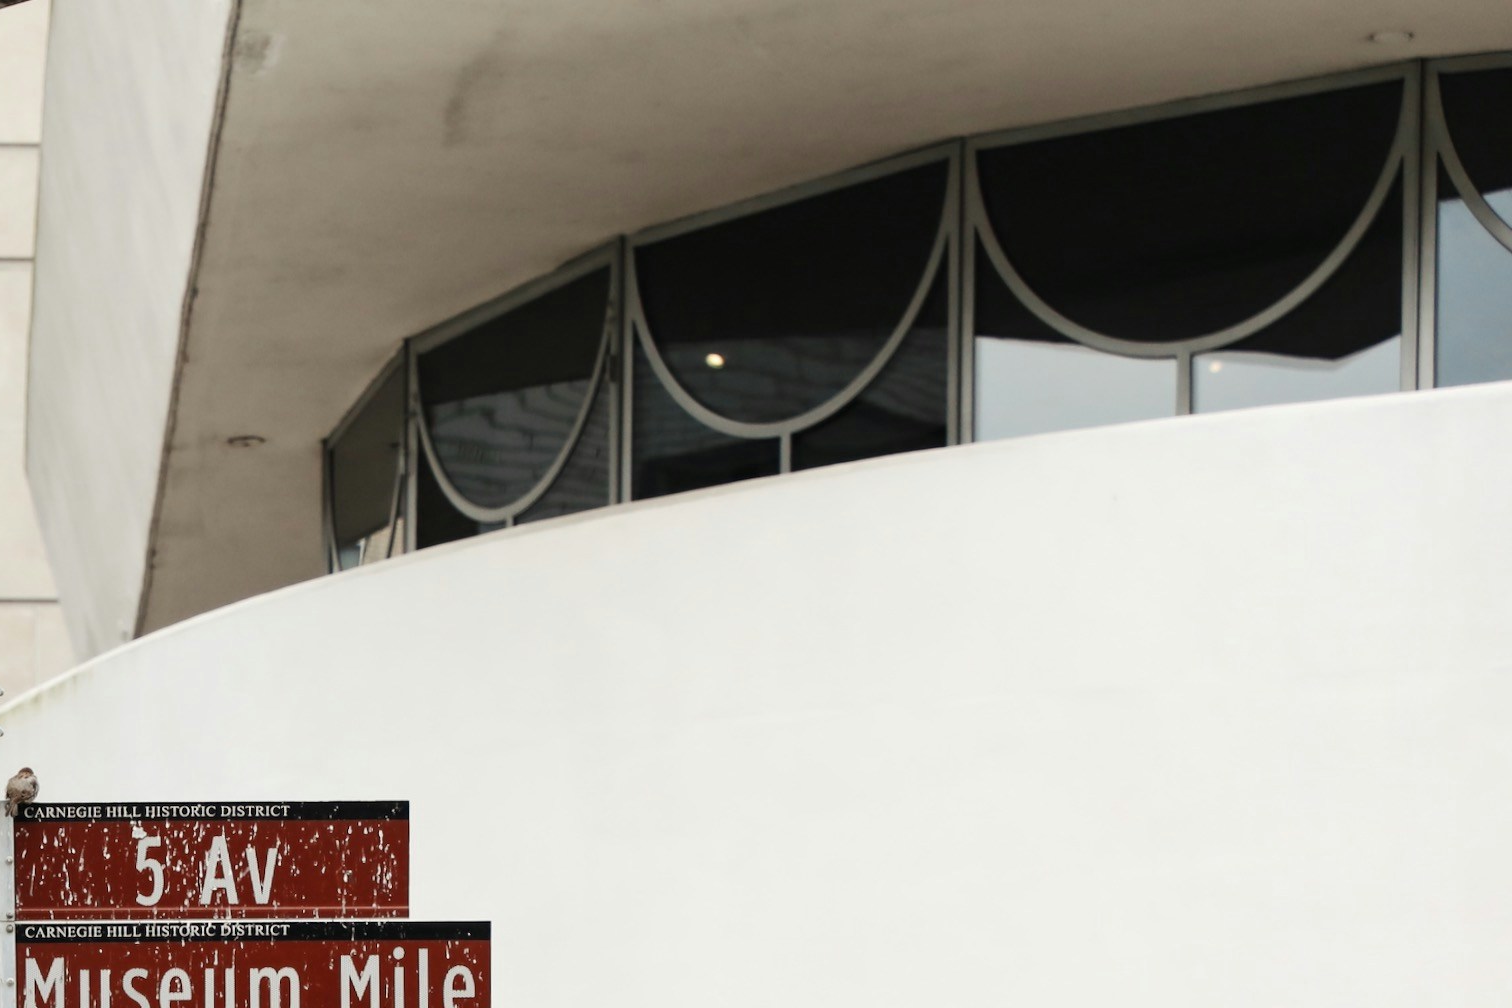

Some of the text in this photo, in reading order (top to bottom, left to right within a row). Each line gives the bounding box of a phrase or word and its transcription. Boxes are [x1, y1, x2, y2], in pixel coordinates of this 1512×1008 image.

[24, 805, 290, 818] CARNEGIE HILL HISTORIC DISTRICT
[135, 836, 278, 906] 5 Av
[25, 925, 290, 938] CARNEGIE HILL HISTORIC DISTRICT
